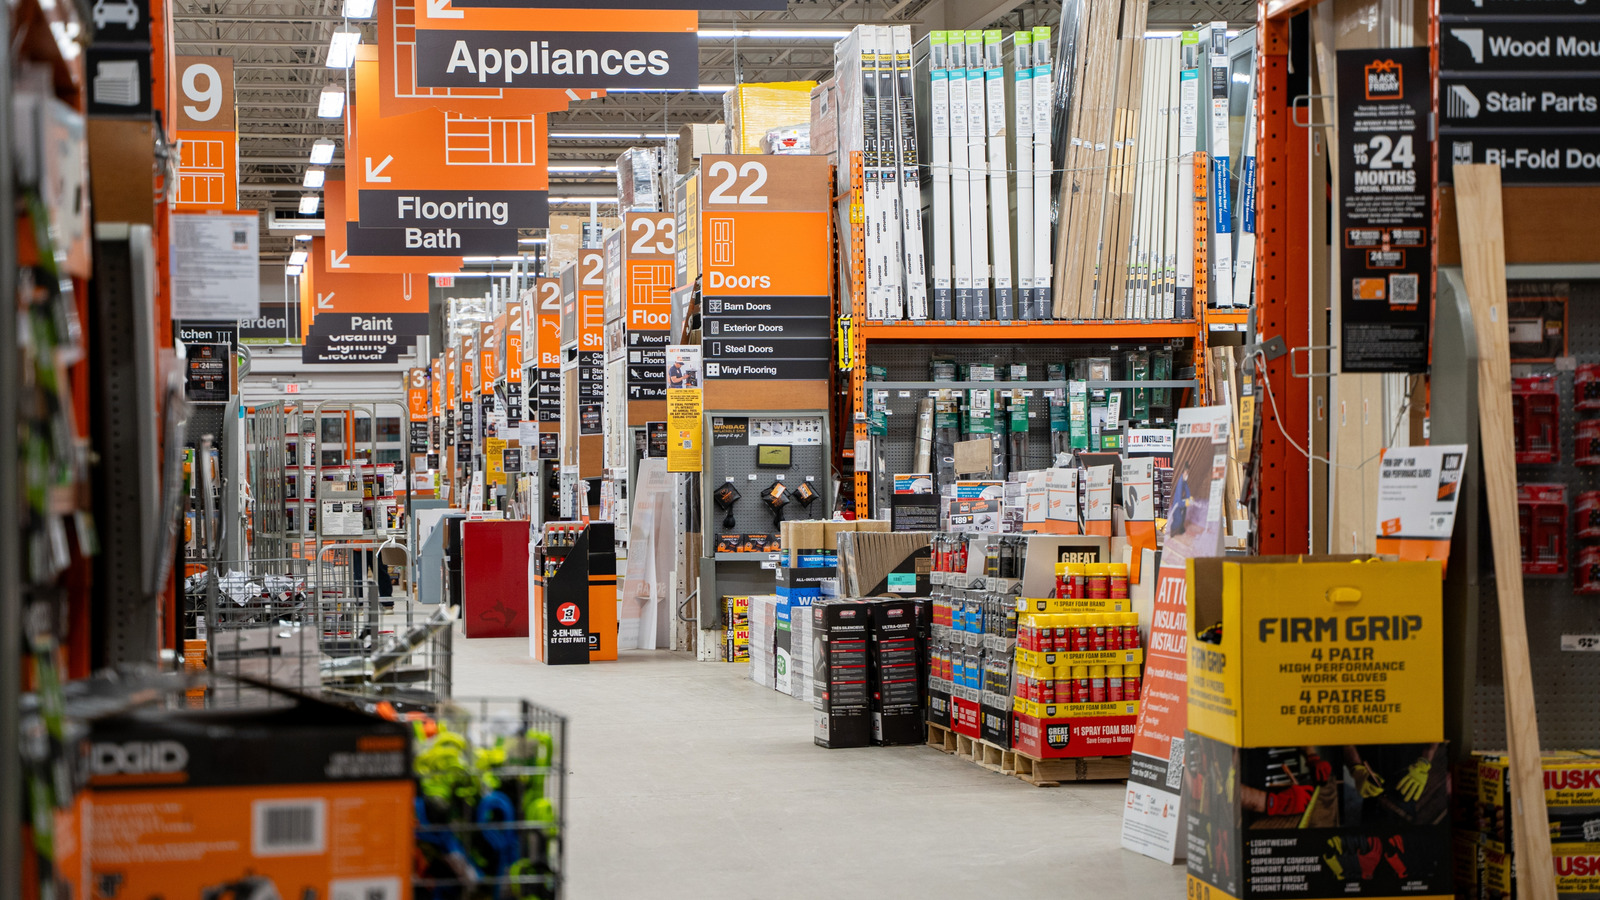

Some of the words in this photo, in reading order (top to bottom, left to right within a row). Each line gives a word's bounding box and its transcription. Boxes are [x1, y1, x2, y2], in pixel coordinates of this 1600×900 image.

[1488, 36, 1550, 56] Wood
[446, 40, 670, 83] Appliances
[1368, 74, 1396, 83] BLACK
[182, 63, 223, 122] 9
[1368, 82, 1399, 92] FRIDAY
[1486, 92, 1536, 112] Stair
[1541, 92, 1598, 112] Parts
[1354, 144, 1368, 154] UP
[1369, 135, 1416, 169] 24
[1354, 155, 1368, 165] TO
[1486, 150, 1560, 168] Bi-Fold
[708, 162, 768, 204] 22
[1354, 170, 1416, 185] MONTHS
[398, 196, 508, 226] Flooring
[405, 228, 460, 249] Bath
[631, 218, 676, 254] 23
[439, 277, 451, 286] EXIT
[709, 272, 770, 288] Doors
[351, 316, 392, 330] Paint
[724, 324, 756, 332] Exterior
[758, 324, 783, 332] Doors
[722, 366, 742, 375] Vinyl
[743, 366, 777, 375] Flooring
[287, 384, 298, 393] EXIT
[1191, 422, 1211, 433] INSTALLED
[1062, 552, 1096, 563] GREAT
[1154, 610, 1187, 630] INSULATI
[1259, 616, 1338, 642] FIRM
[1346, 615, 1422, 642] GRIP
[1311, 648, 1322, 661] 4
[1329, 647, 1374, 661] PAIR
[1279, 664, 1311, 673] HIGH
[1314, 661, 1405, 673] PERFORMANCE
[1301, 674, 1338, 683] WORK
[1341, 672, 1387, 682] GLOVES
[1300, 690, 1312, 703] 4
[1318, 689, 1386, 702] PAIRES
[1281, 705, 1296, 715] DE
[1300, 704, 1341, 714] GANTS
[1344, 704, 1360, 714] DE
[1363, 703, 1401, 713] HAUTE
[1298, 714, 1388, 725] PERFORMANCE
[1048, 727, 1068, 735] GREAT
[1074, 728, 1079, 736] #1
[1081, 726, 1101, 736] SPRAY
[1102, 725, 1119, 735] FOAM
[1049, 735, 1068, 743] STUFF
[1544, 769, 1600, 790] USK
[1251, 839, 1297, 847] LIGHTWEIGHT
[1251, 857, 1283, 865] SUPERIOR
[1553, 856, 1600, 876] USK
[1251, 865, 1281, 874] CONFORT
[1283, 864, 1321, 873] SUPÉRIEUR
